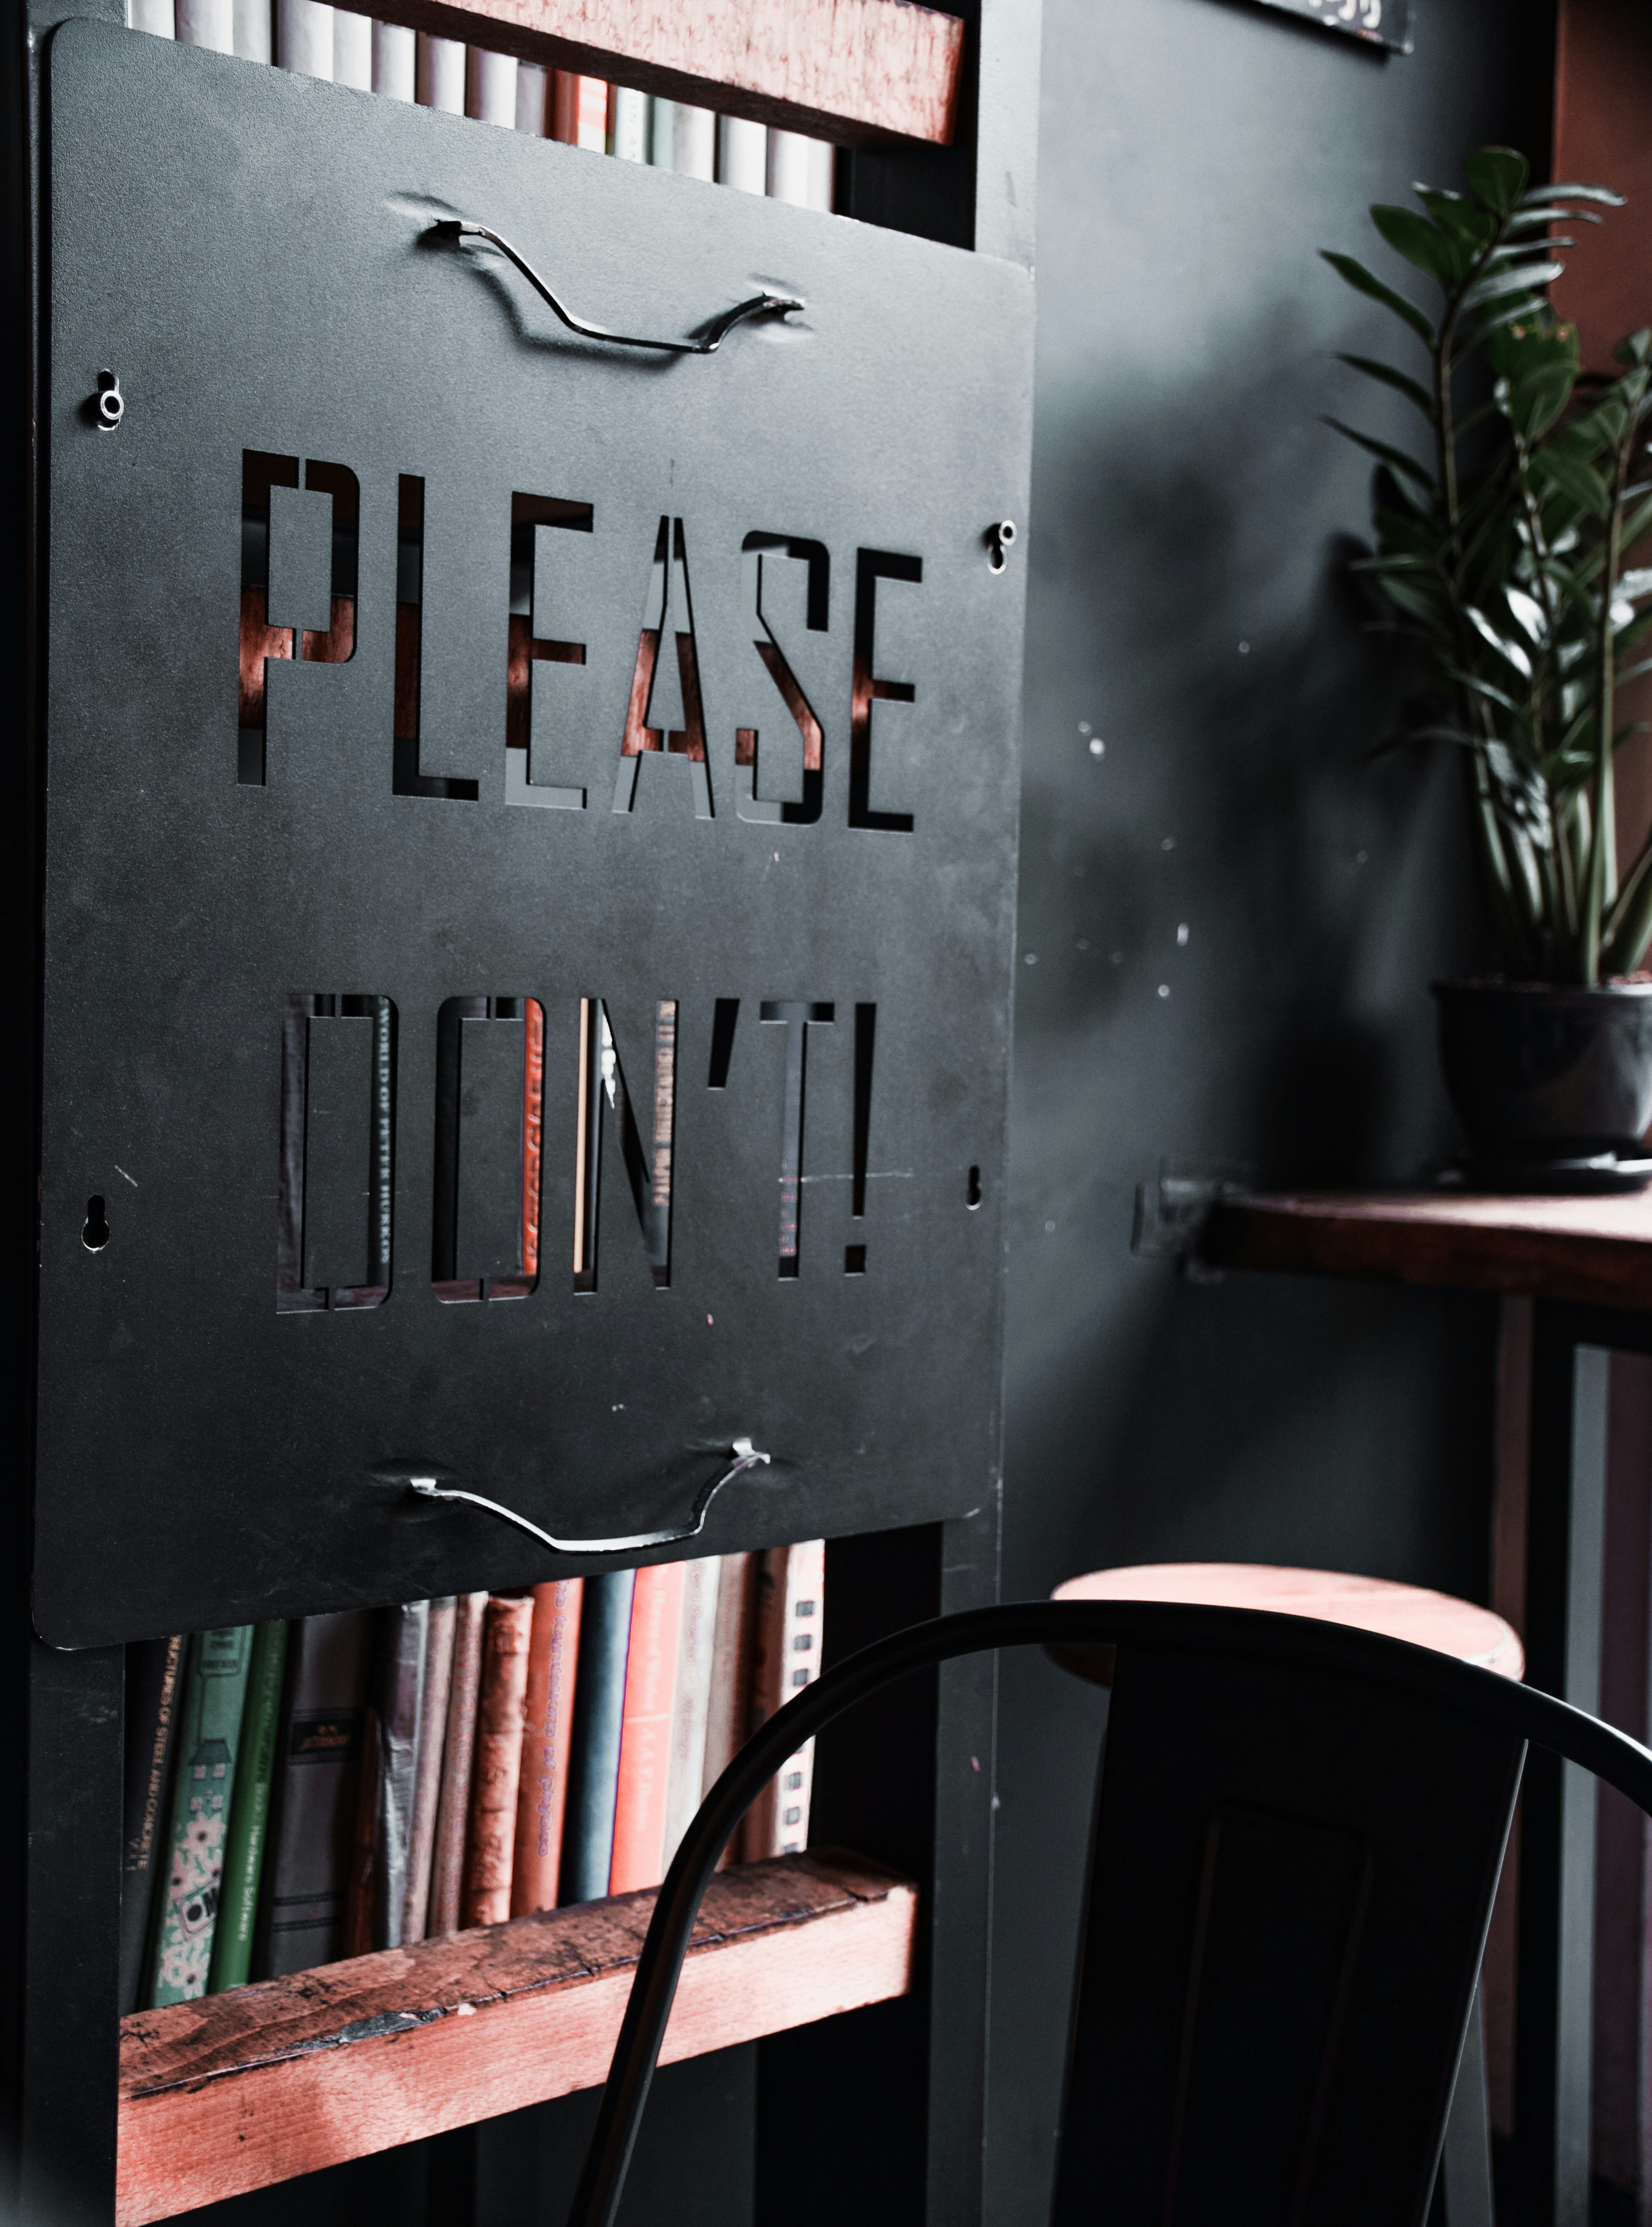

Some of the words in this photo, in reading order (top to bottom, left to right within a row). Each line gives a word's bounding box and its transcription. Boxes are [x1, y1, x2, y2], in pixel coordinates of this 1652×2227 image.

[237, 448, 923, 834] PLEASE
[379, 1008, 390, 1084] WORLD
[379, 1085, 390, 1113] OF
[275, 993, 877, 1315] DON'T!
[378, 1116, 390, 1179] PETER
[554, 1579, 571, 1608] he
[160, 1635, 182, 1706] RUCTURES
[544, 1614, 568, 1738] foundations
[158, 1706, 171, 1725] OF
[152, 1726, 169, 1768] STEEL
[542, 1744, 558, 1770] of
[148, 1769, 161, 1797] AND
[138, 1798, 158, 1868] CONCRETE
[536, 1776, 555, 1858] physics
[244, 1825, 261, 1884] Hardware
[237, 1885, 256, 1942] Software
